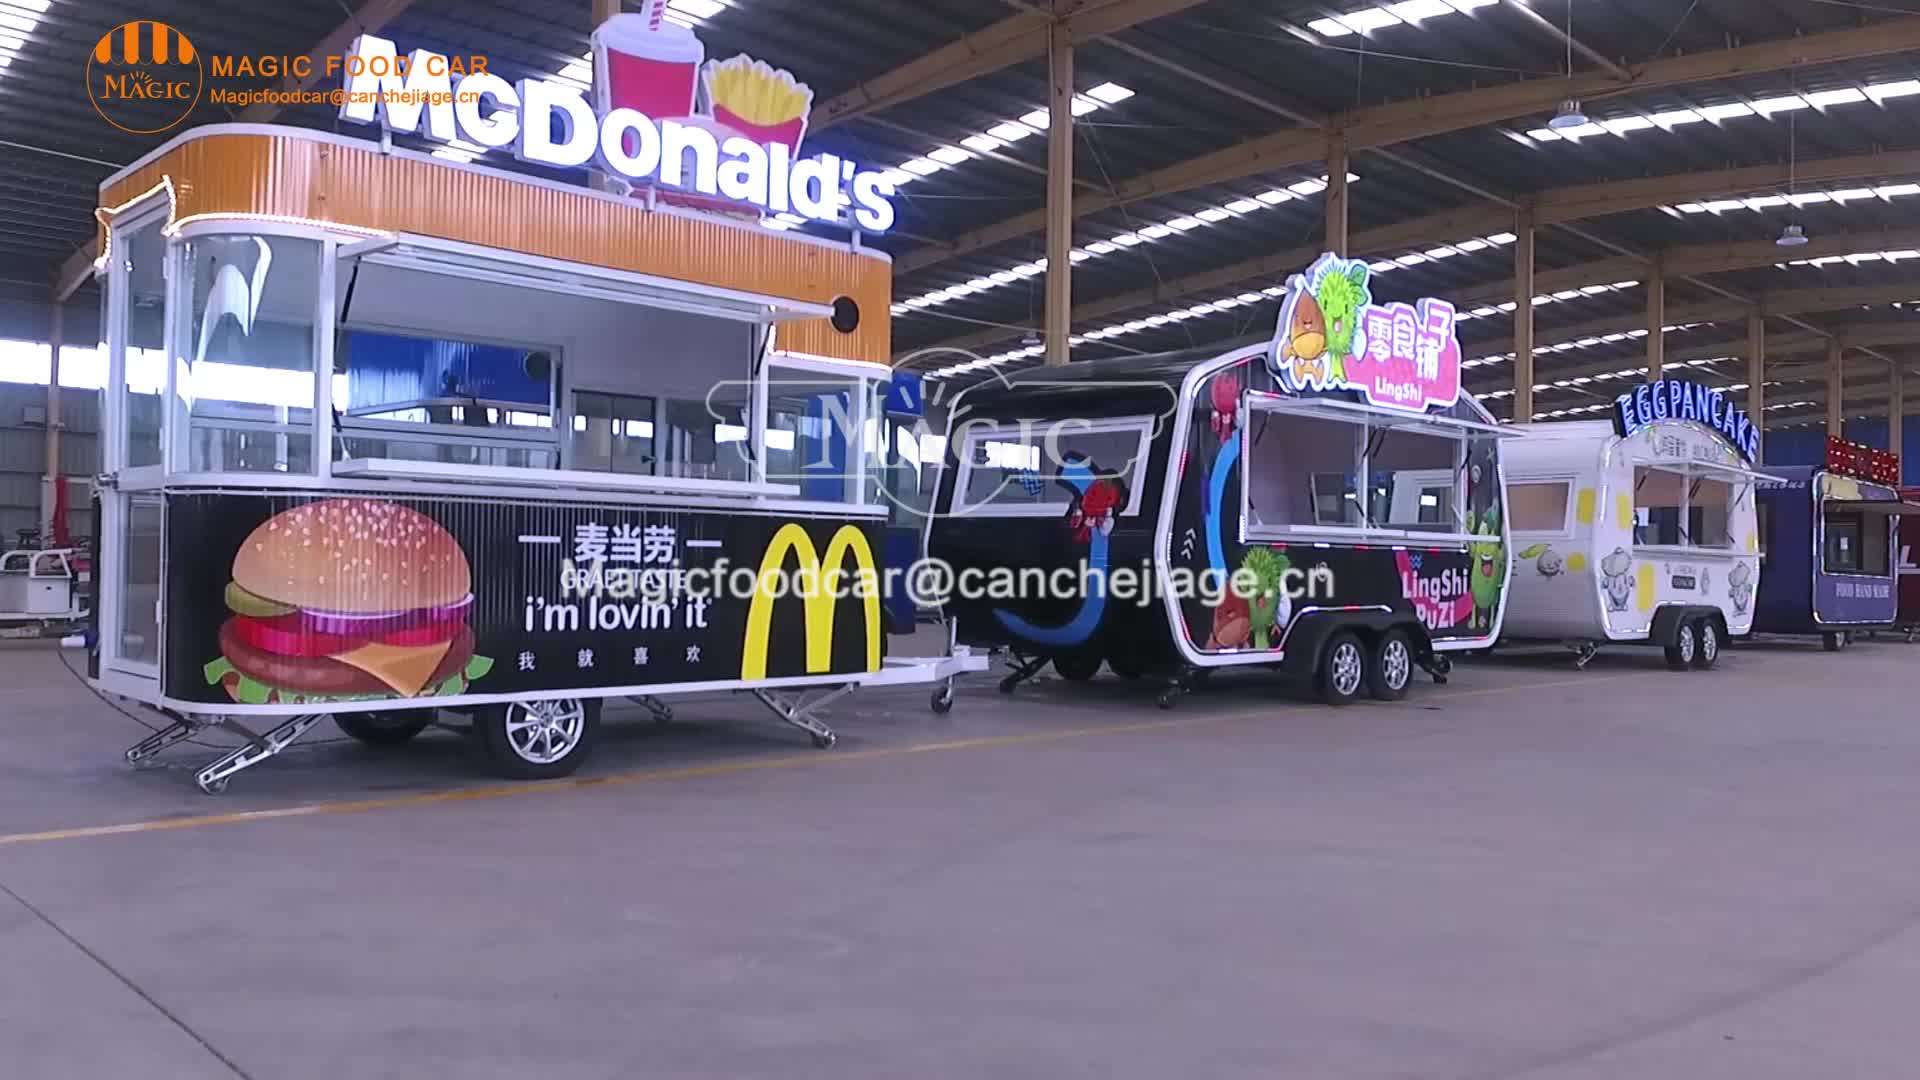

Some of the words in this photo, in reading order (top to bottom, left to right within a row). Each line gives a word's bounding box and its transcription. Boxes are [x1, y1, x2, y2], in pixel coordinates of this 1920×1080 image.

[340, 34, 897, 233] McDonald's
[1374, 376, 1423, 401] LingShi
[573, 522, 677, 564] 麦当劳
[1401, 567, 1469, 604] LingShi
[525, 595, 579, 632] i'm
